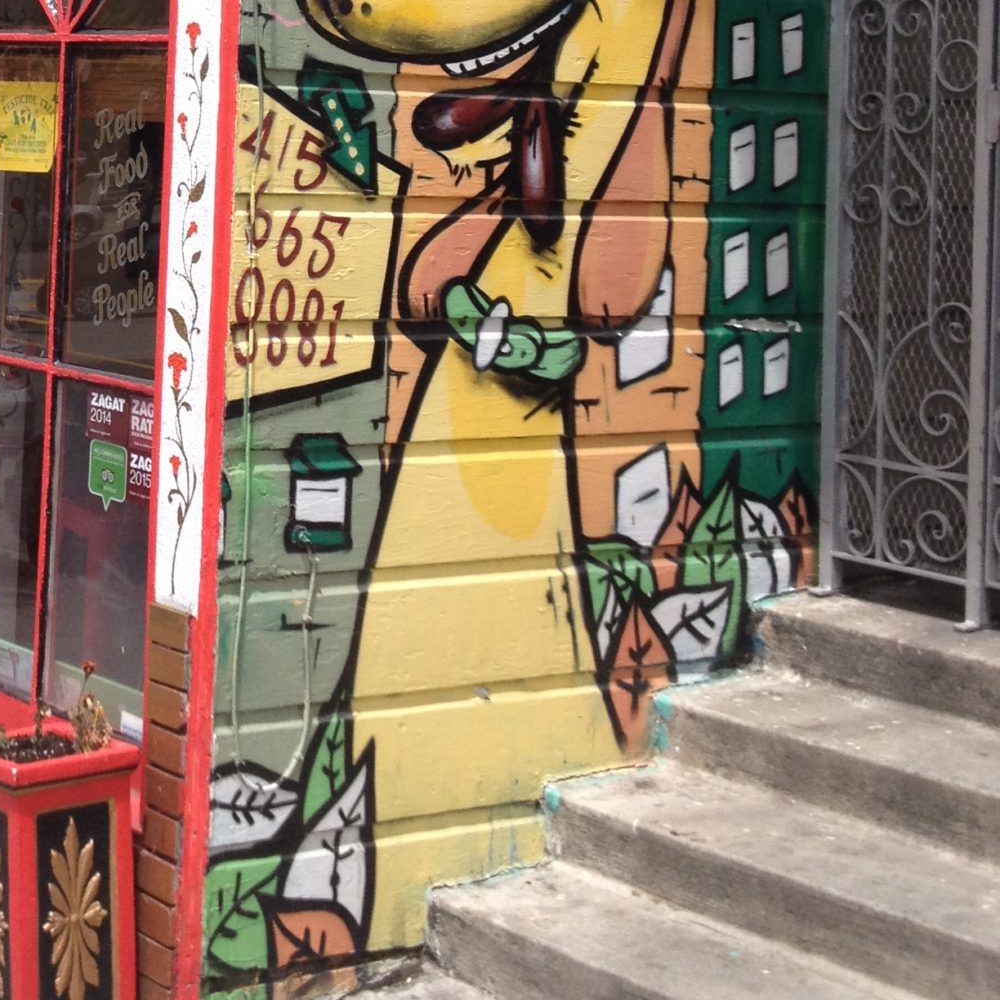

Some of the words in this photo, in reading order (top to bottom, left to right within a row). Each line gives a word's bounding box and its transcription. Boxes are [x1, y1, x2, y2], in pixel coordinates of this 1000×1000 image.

[94, 91, 148, 149] Real
[98, 141, 148, 195] Food
[98, 221, 148, 274] Real
[247, 178, 351, 279] 665
[92, 269, 155, 328] People
[90, 408, 112, 425] 2014
[91, 392, 126, 413] ZAGAT
[129, 470, 152, 488] 2015
